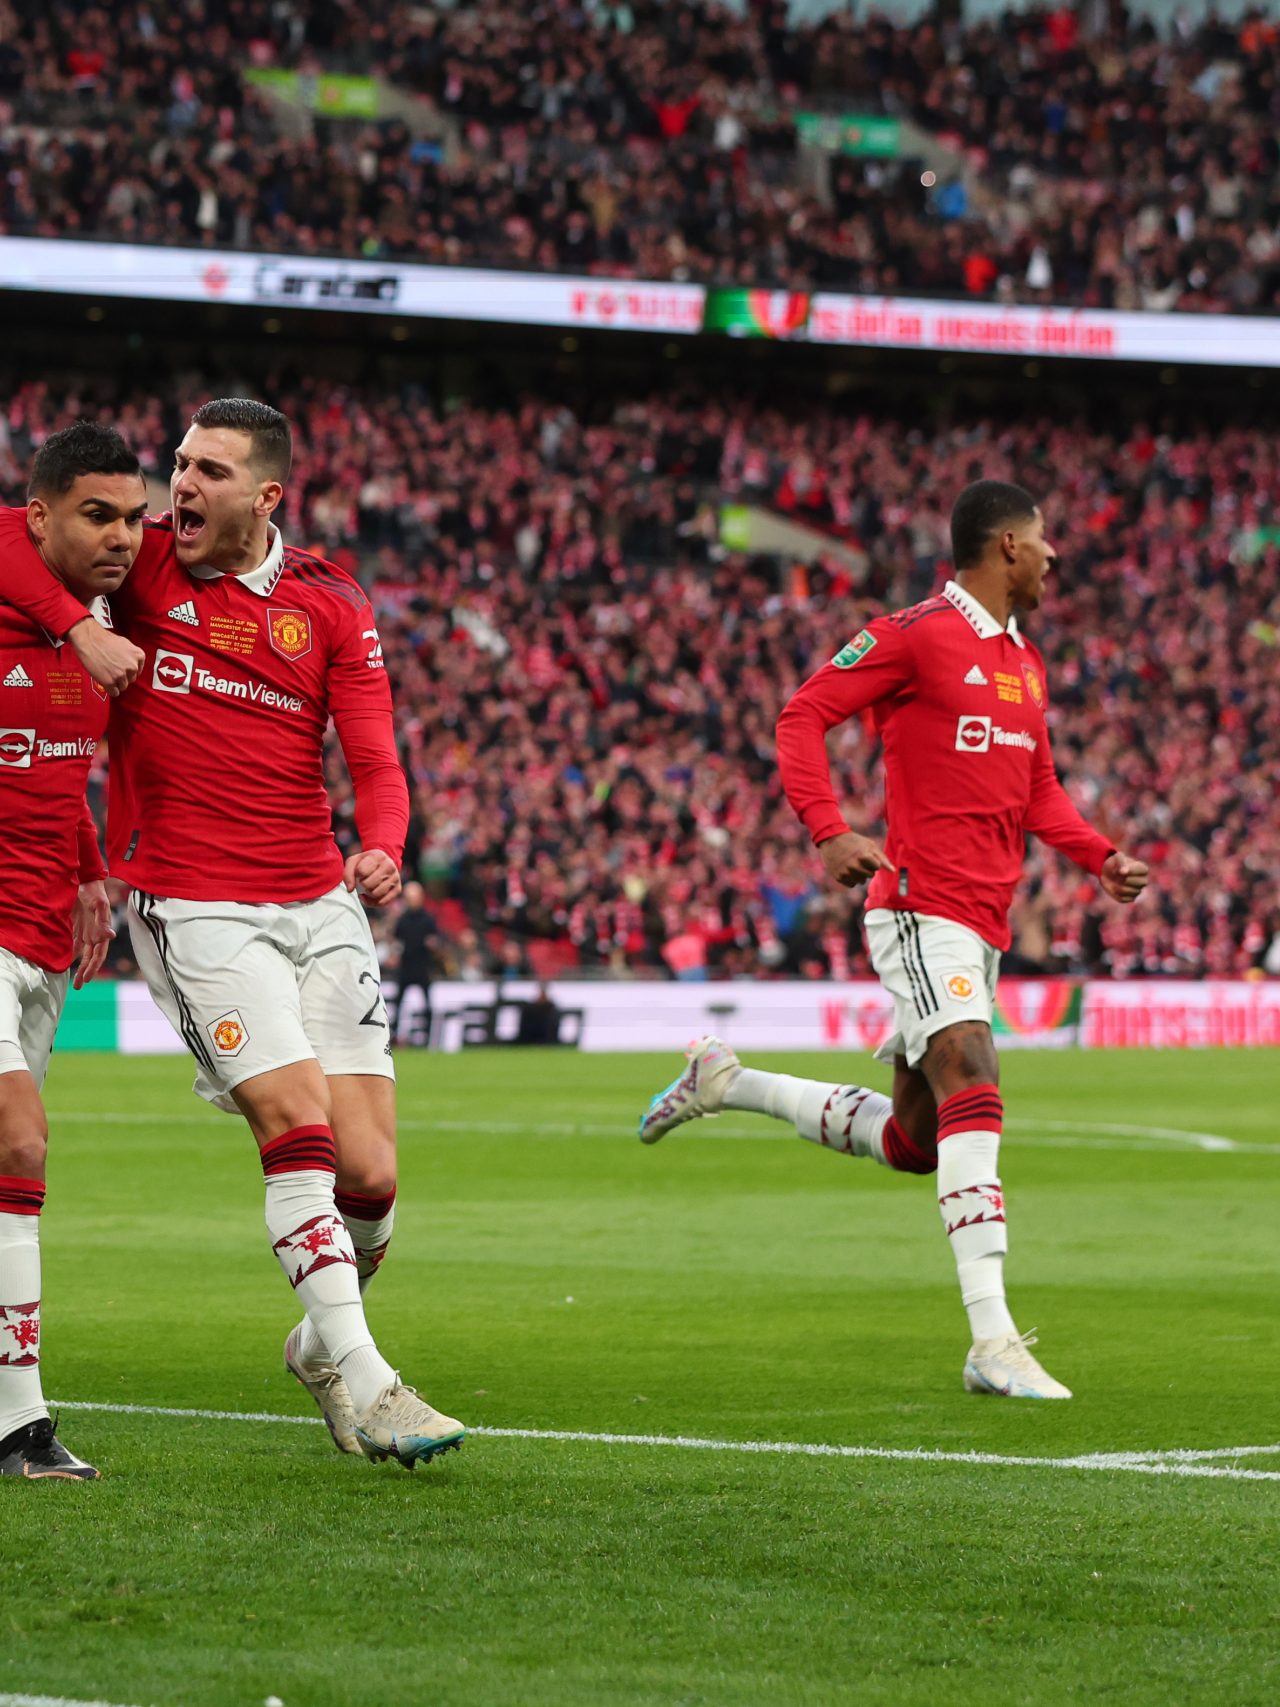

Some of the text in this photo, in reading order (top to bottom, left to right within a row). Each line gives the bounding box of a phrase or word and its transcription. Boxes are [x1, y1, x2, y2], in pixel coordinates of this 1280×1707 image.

[167, 610, 200, 627] adidas
[3, 679, 34, 687] adidas
[195, 668, 308, 712] TeamViewer
